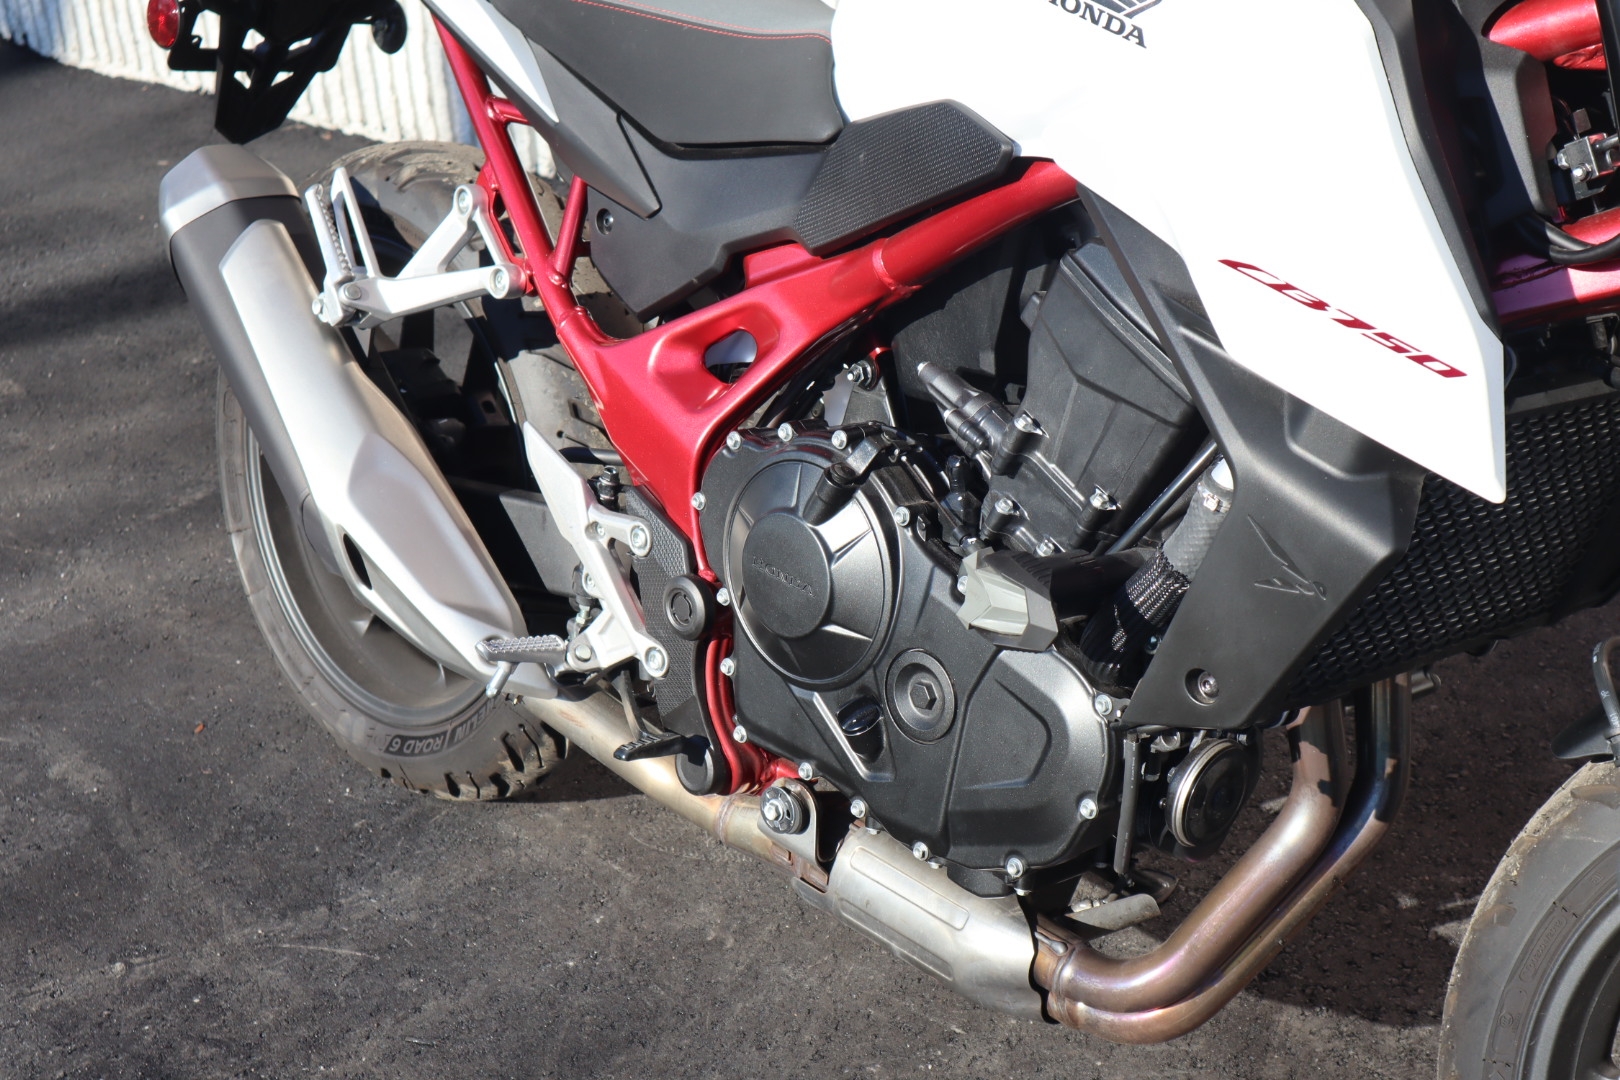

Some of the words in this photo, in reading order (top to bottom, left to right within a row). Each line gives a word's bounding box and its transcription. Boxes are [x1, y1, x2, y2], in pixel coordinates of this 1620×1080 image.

[1217, 259, 1468, 378] CB750
[752, 556, 816, 599] HONDA
[388, 737, 402, 752] 6
[403, 734, 444, 754] ROAD
